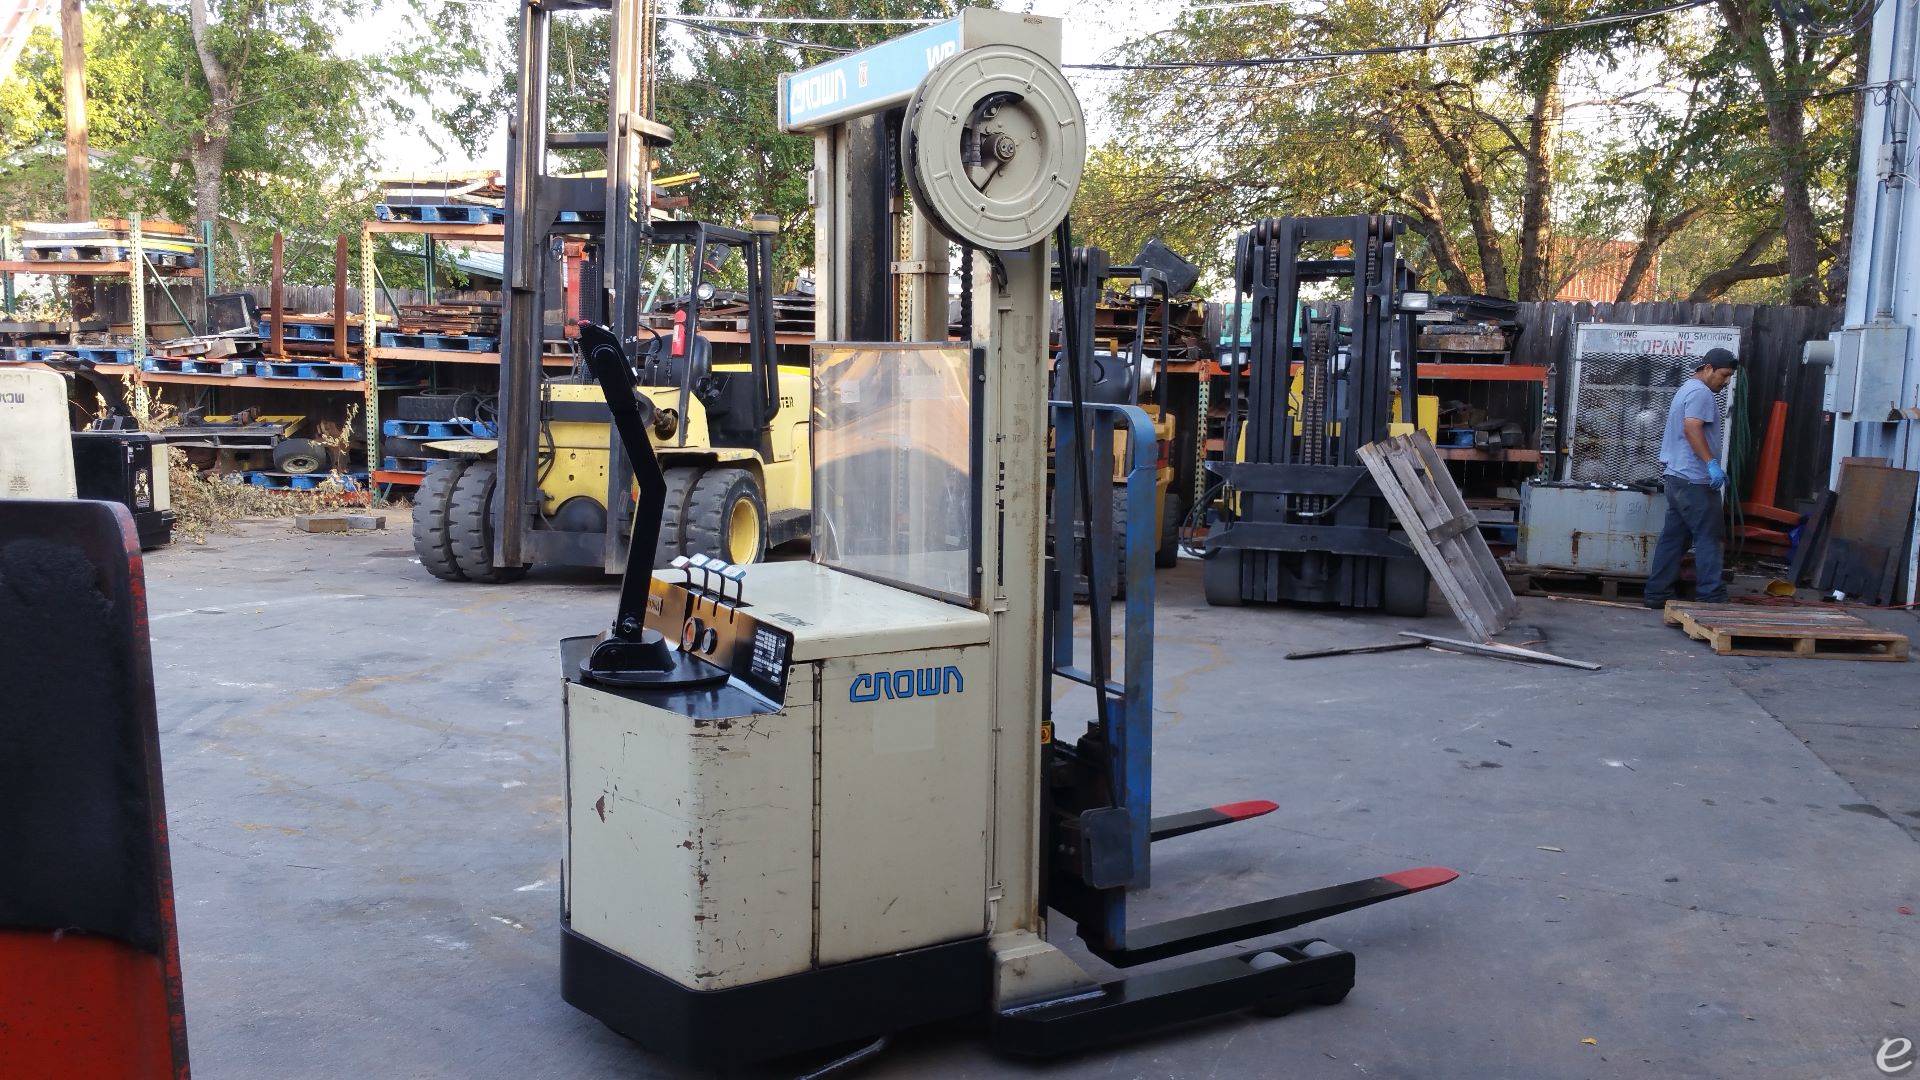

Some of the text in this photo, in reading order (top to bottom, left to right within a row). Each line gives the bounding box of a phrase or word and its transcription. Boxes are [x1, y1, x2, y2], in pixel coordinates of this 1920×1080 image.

[791, 69, 847, 115] CROWN
[1619, 339, 1695, 356] PROPANE
[1679, 332, 1733, 341] NO SMOKING
[850, 665, 963, 702] CROWN
